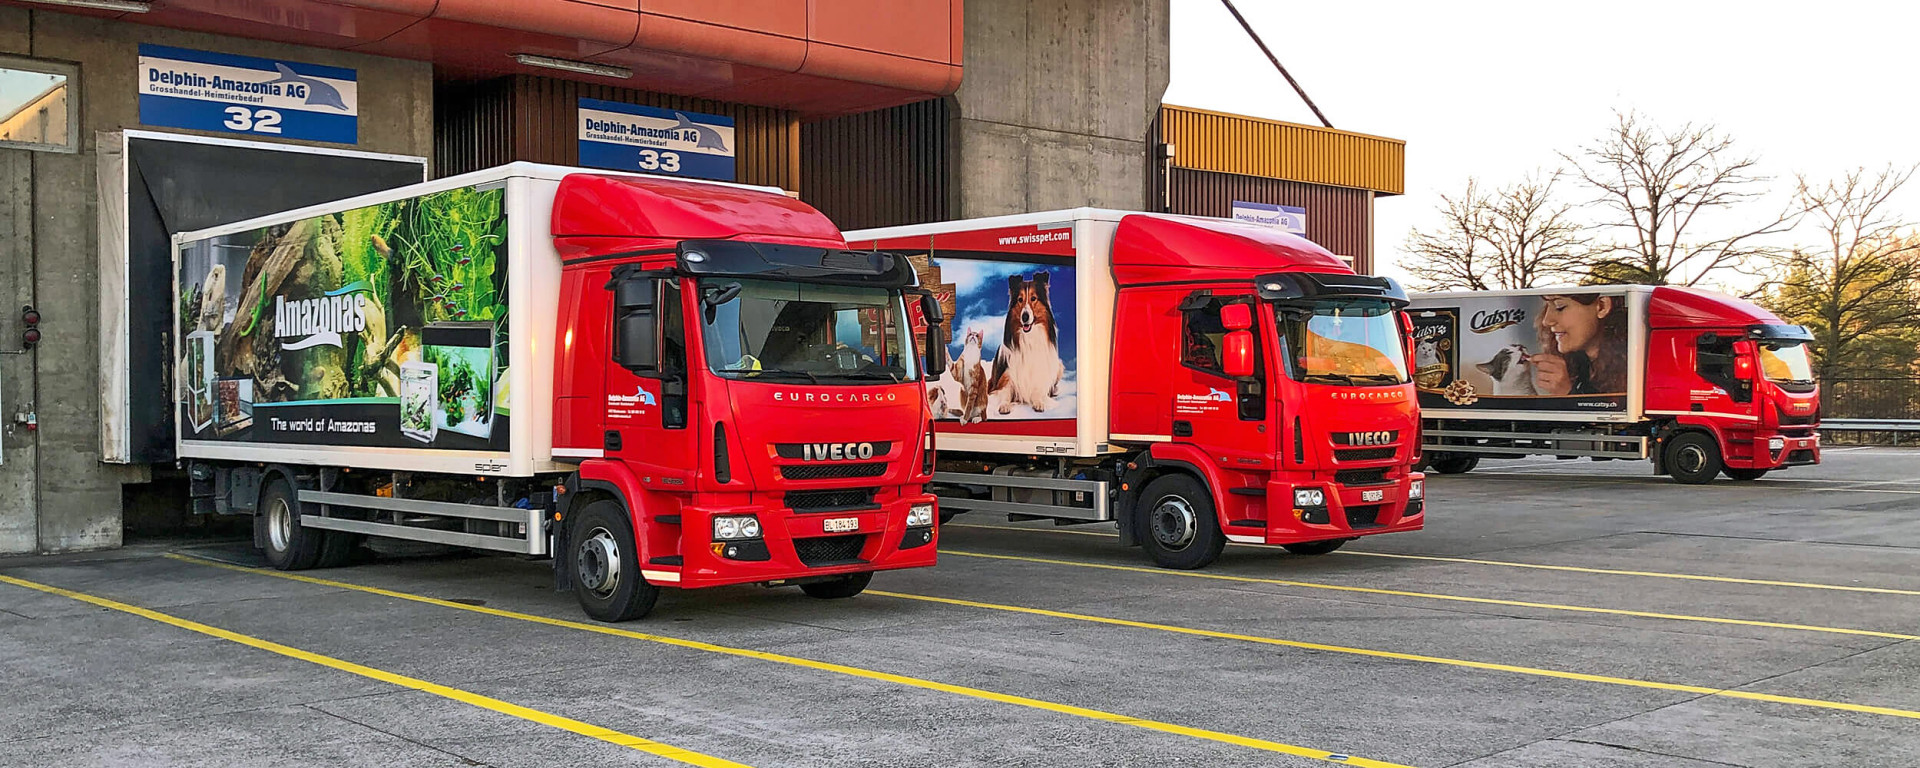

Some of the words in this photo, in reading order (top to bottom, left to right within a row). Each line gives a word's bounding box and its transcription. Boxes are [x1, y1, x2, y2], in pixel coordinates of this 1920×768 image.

[149, 68, 281, 97] Delphin-Amazonia
[286, 84, 305, 99] AG
[149, 84, 264, 104] Grosshandel-Heimtierbedarf
[223, 106, 282, 134] 32
[585, 118, 680, 141] Delphin-Amazonia
[683, 130, 697, 143] AG
[638, 150, 681, 172] 33
[998, 232, 1070, 245] www.swisspet.com
[275, 293, 366, 338] Amazonas
[1470, 308, 1515, 330] Catsy
[773, 392, 896, 402] EUROCARGO
[1331, 391, 1403, 400] EUROCARGO
[270, 418, 287, 431] The
[289, 418, 313, 432] world
[316, 418, 325, 432] of
[327, 418, 376, 433] Amazonas
[1348, 431, 1390, 446] IVECO
[803, 442, 874, 461] IVECO
[475, 459, 507, 473] spier
